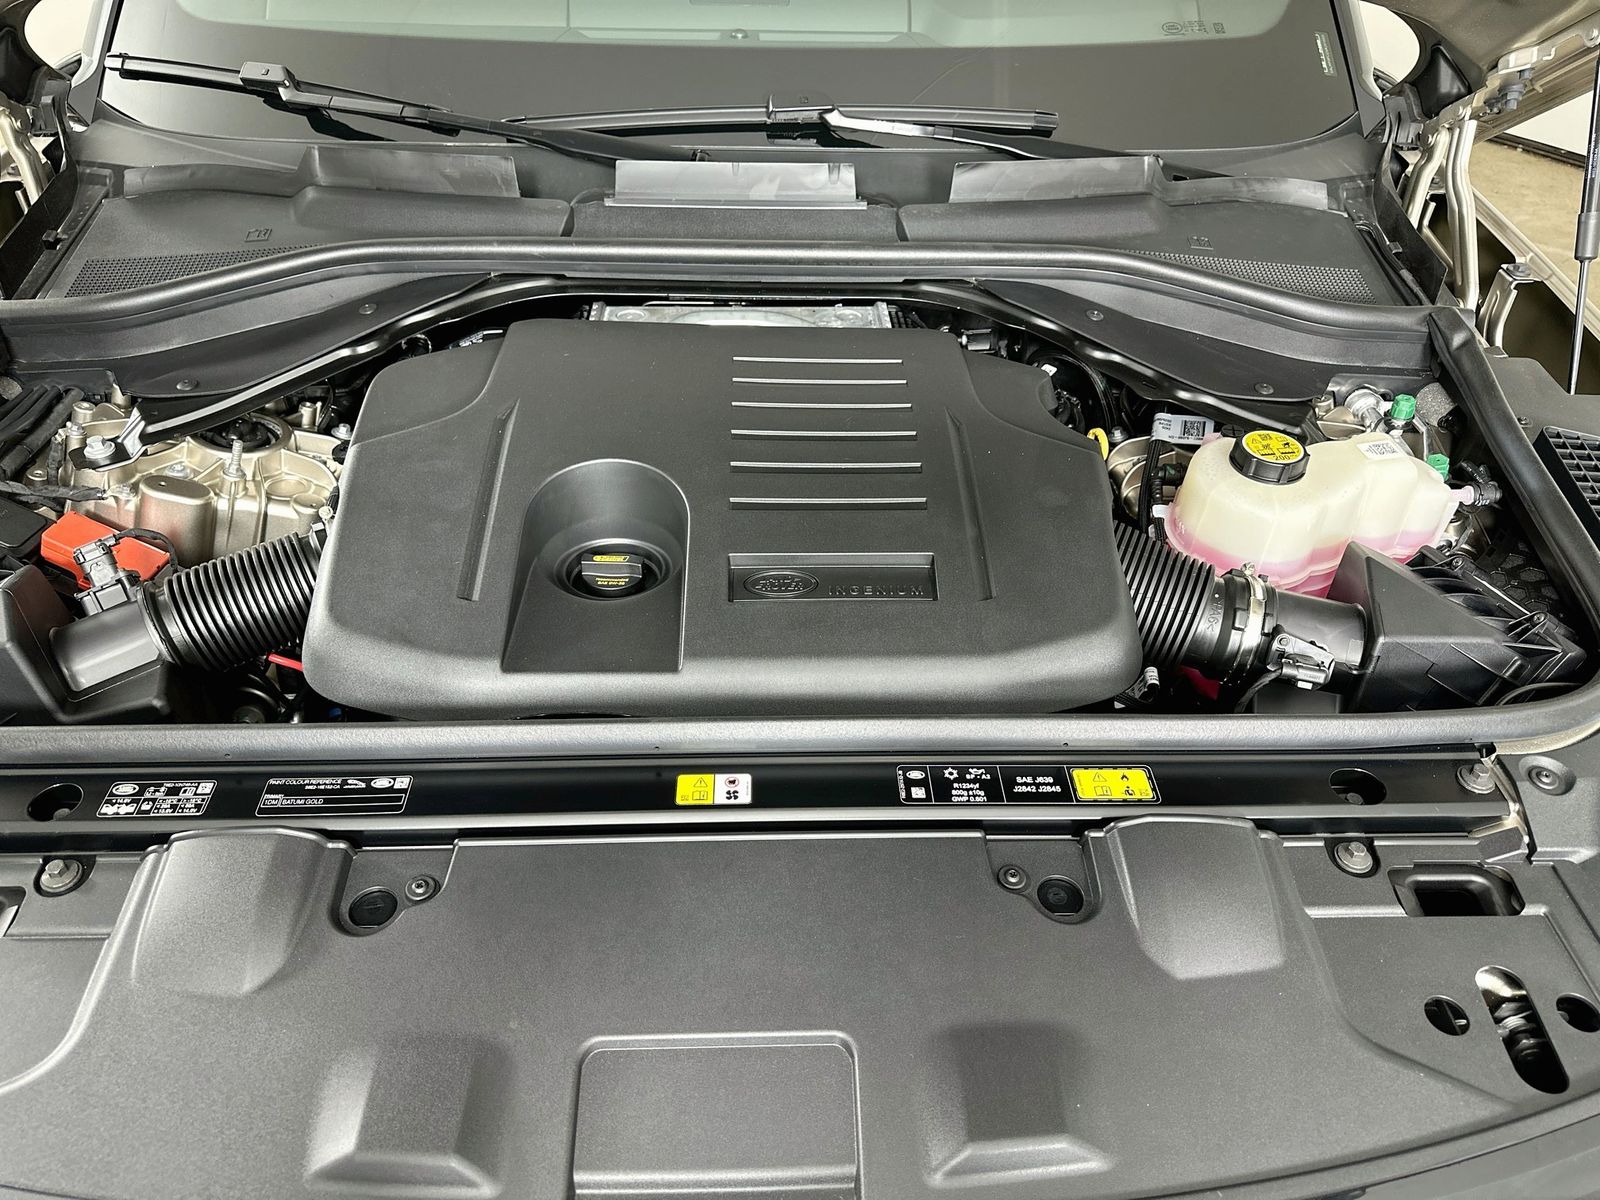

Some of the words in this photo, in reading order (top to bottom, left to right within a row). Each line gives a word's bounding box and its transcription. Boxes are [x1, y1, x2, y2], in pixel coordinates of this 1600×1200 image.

[828, 585, 924, 596] INGENIUM
[1012, 785, 1037, 793] J2842
[1037, 785, 1062, 793] J2845
